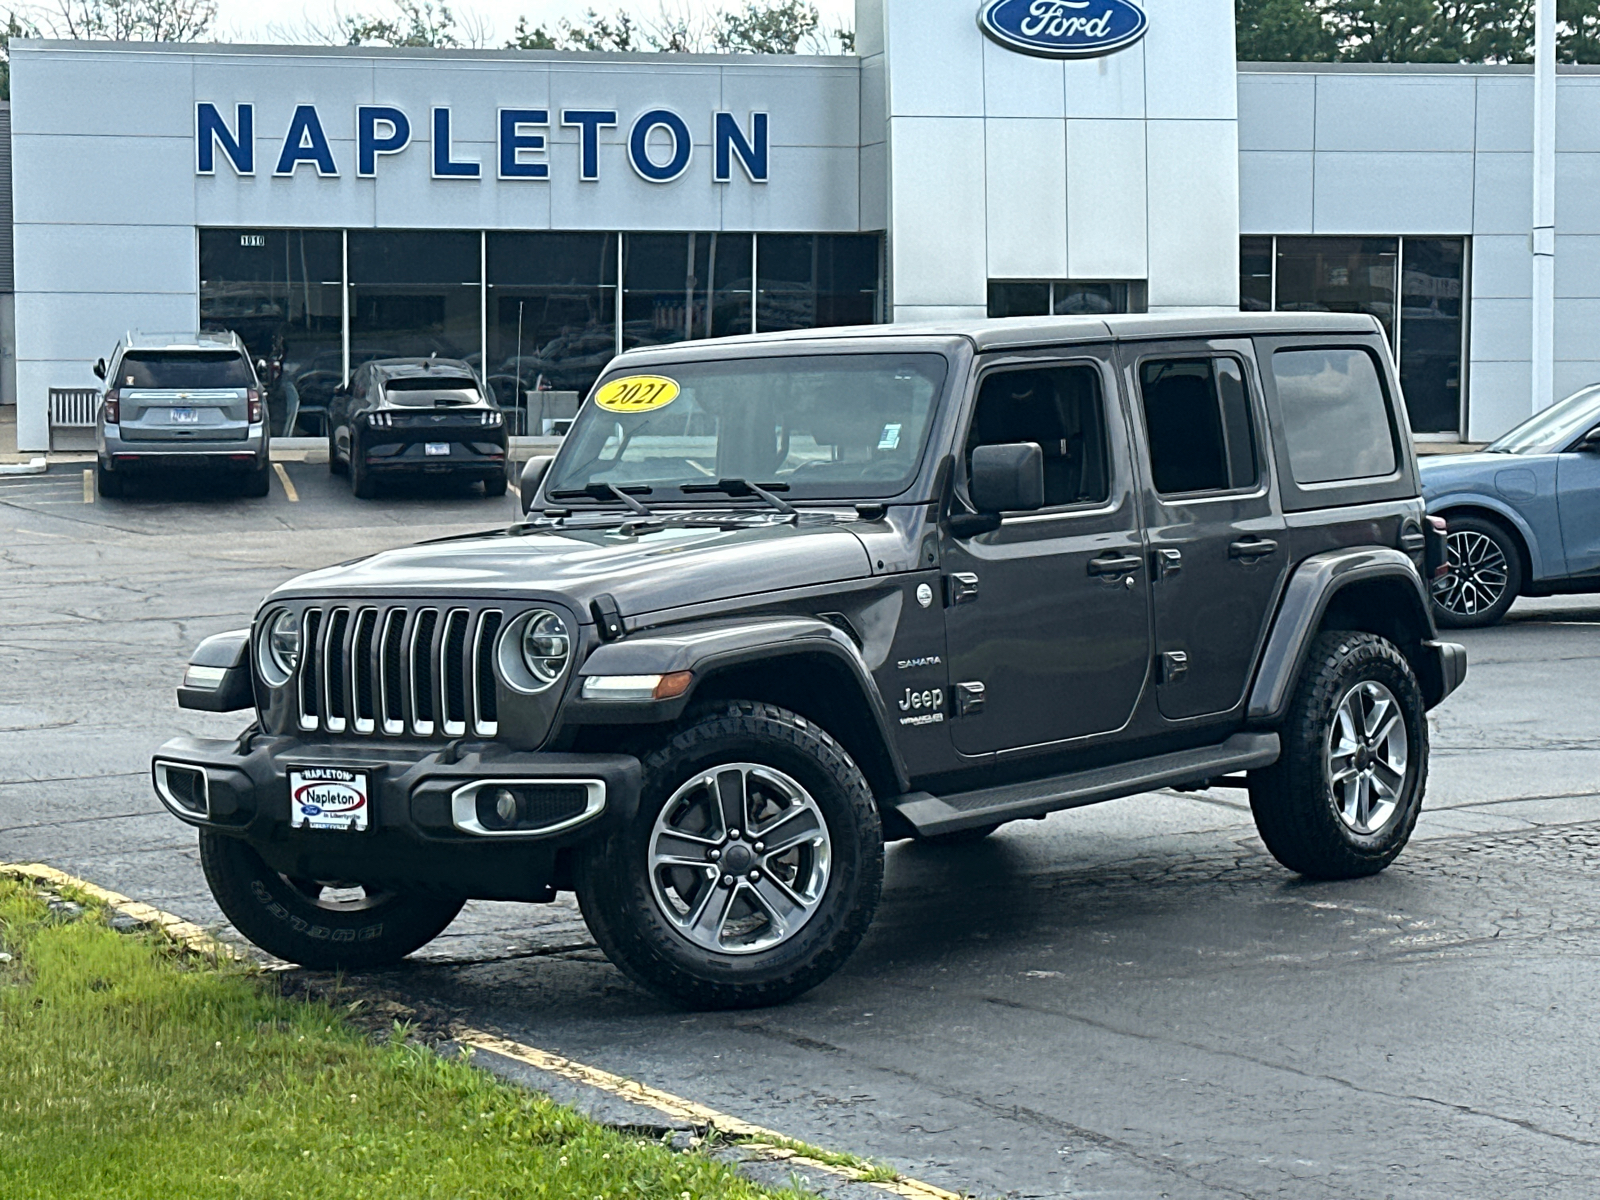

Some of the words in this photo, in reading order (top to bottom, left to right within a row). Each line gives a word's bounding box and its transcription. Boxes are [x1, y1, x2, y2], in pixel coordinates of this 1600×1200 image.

[1021, 0, 1113, 37] Ford
[195, 101, 769, 183] NAPLETON
[605, 383, 668, 405] 2021
[898, 656, 941, 669] SAHARA
[898, 687, 943, 711] Jeep
[304, 769, 351, 780] NAPLETON
[306, 788, 354, 807] Napleton
